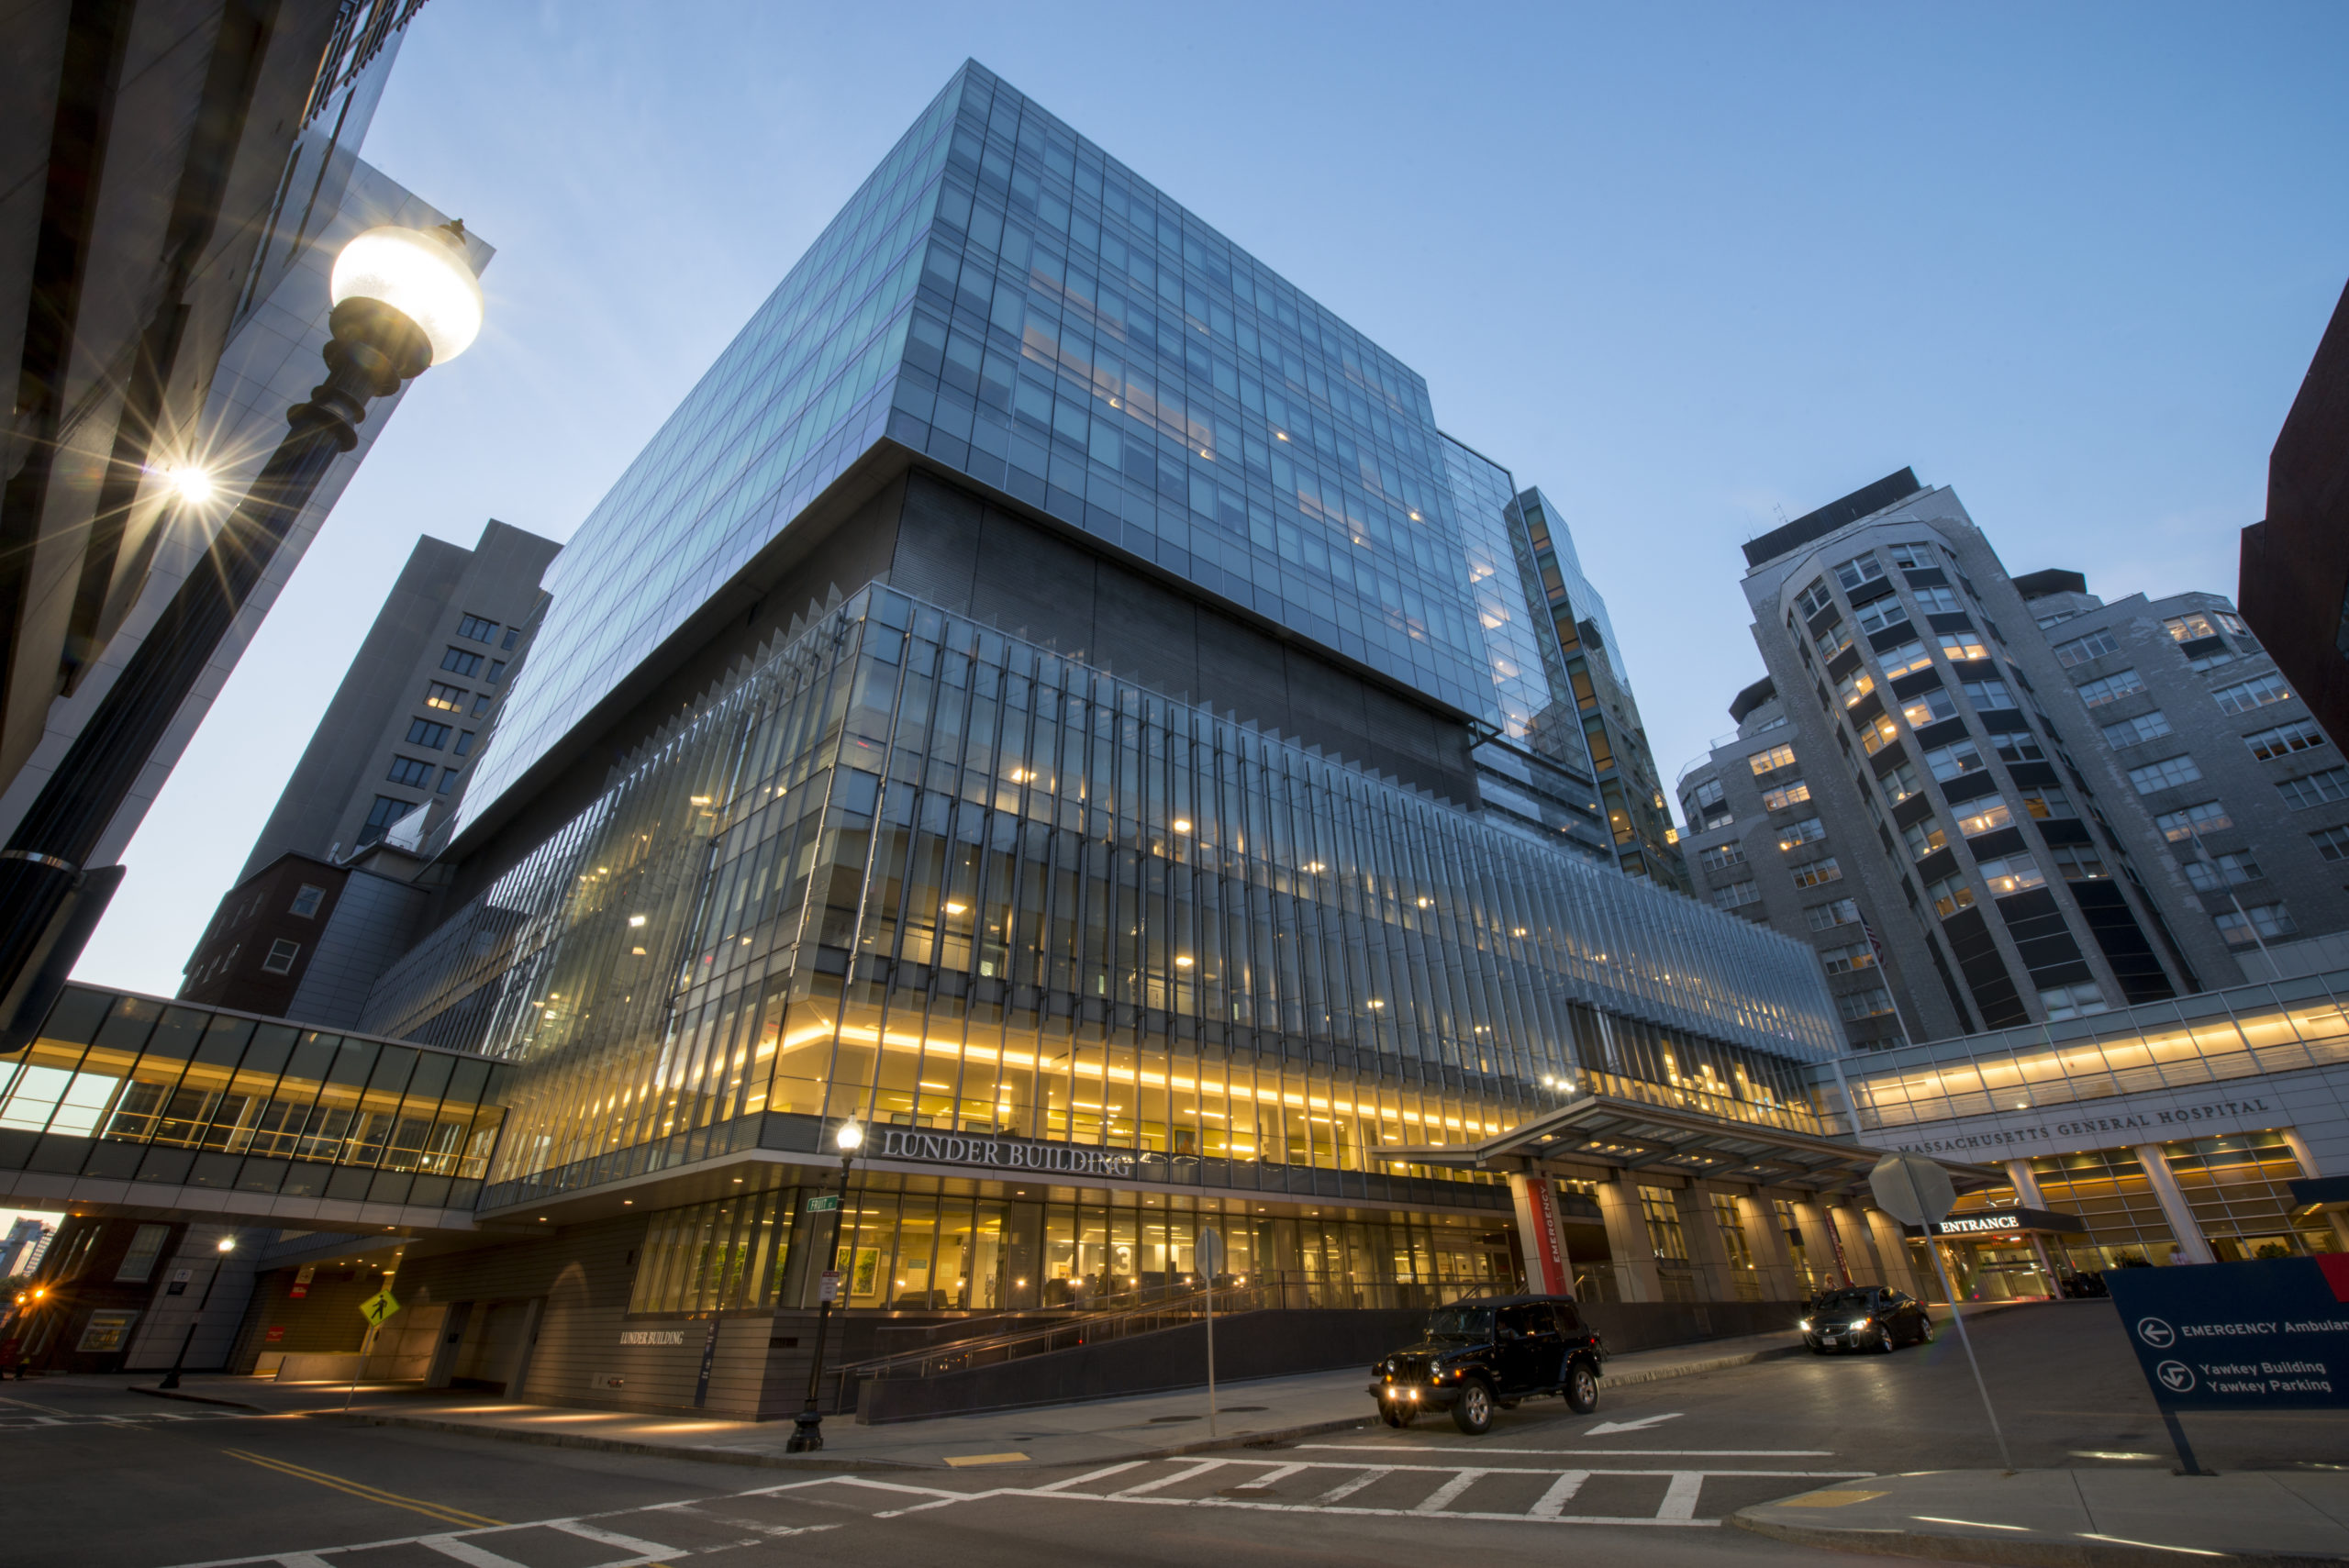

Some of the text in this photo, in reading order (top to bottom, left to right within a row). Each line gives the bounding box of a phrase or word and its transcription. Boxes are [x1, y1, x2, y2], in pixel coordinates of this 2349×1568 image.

[1898, 1099, 2269, 1153] MASSACHUSETTS GENERAL HOSPITAL
[884, 1130, 1130, 1176] LUNDER BUILDING
[810, 1199, 827, 1210] FRUIT
[1540, 1186, 1560, 1262] EMERGENCY
[1940, 1217, 2019, 1233] ENTRANCE
[1116, 1246, 1131, 1276] 3
[2181, 1322, 2277, 1337] EMERGENCY
[620, 1331, 684, 1345] LUNDER BUILDING
[2199, 1361, 2326, 1376] Yawkey Building
[2207, 1379, 2332, 1395] Yawkey Parking
